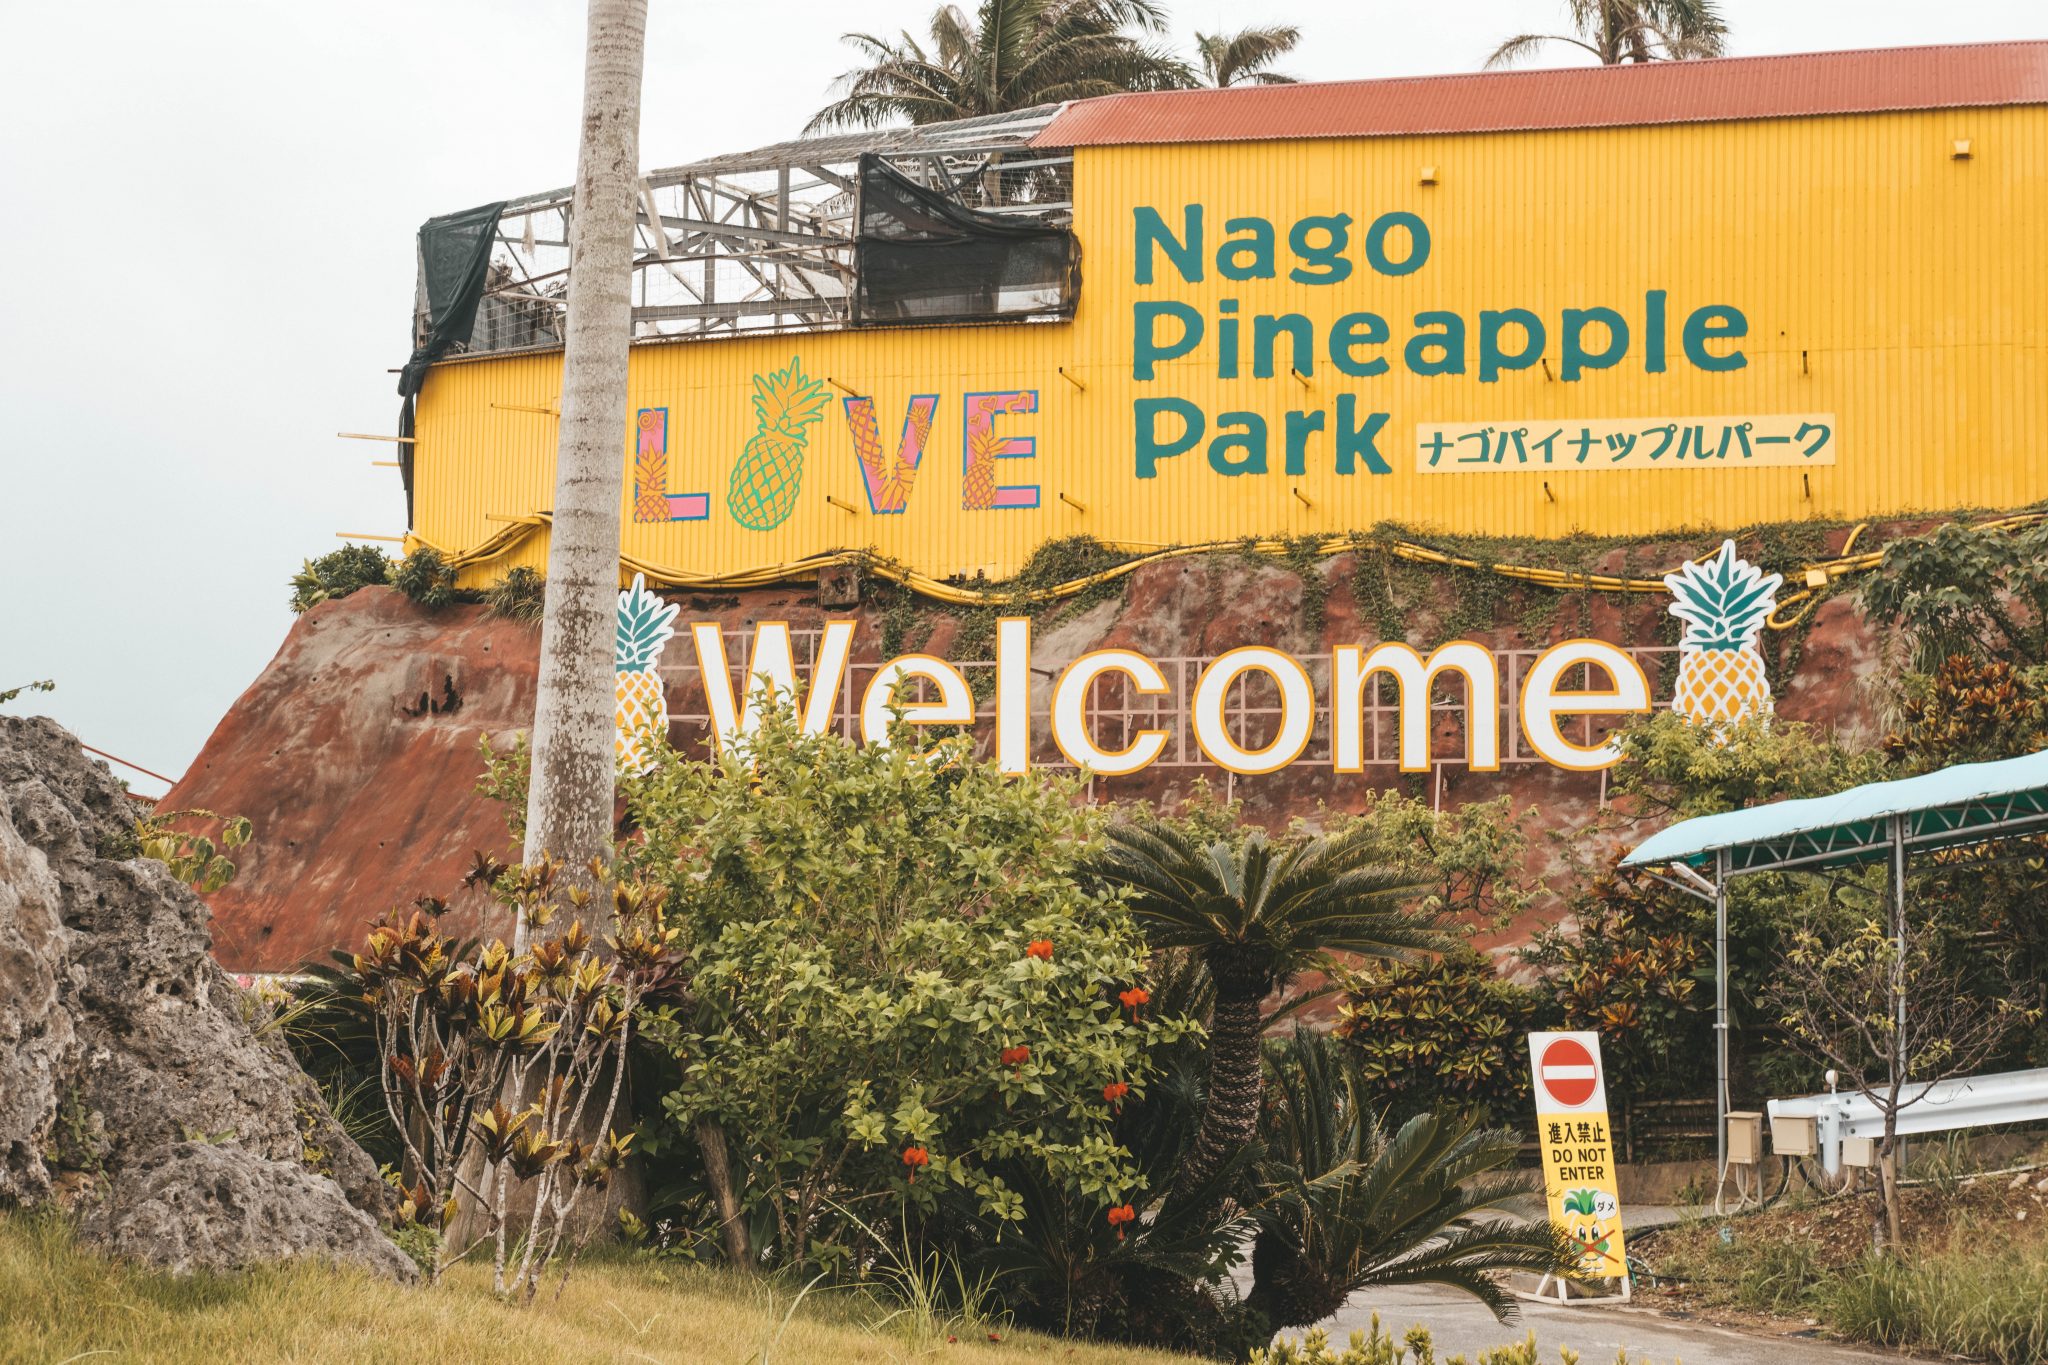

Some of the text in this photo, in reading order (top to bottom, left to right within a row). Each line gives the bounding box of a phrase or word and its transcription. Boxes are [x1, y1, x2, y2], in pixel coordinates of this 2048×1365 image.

[1133, 204, 1431, 285] Nago
[1133, 290, 1749, 383] Pineapple
[1134, 394, 1392, 479] Park
[1420, 421, 1831, 467] ナゴパイナップルパーク
[690, 616, 1651, 776] Welcome
[1548, 1121, 1606, 1144] 進入禁止
[1552, 1148, 1606, 1163] DO NOT
[1560, 1166, 1605, 1180] ENTER
[1597, 1201, 1615, 1212] ダメ
